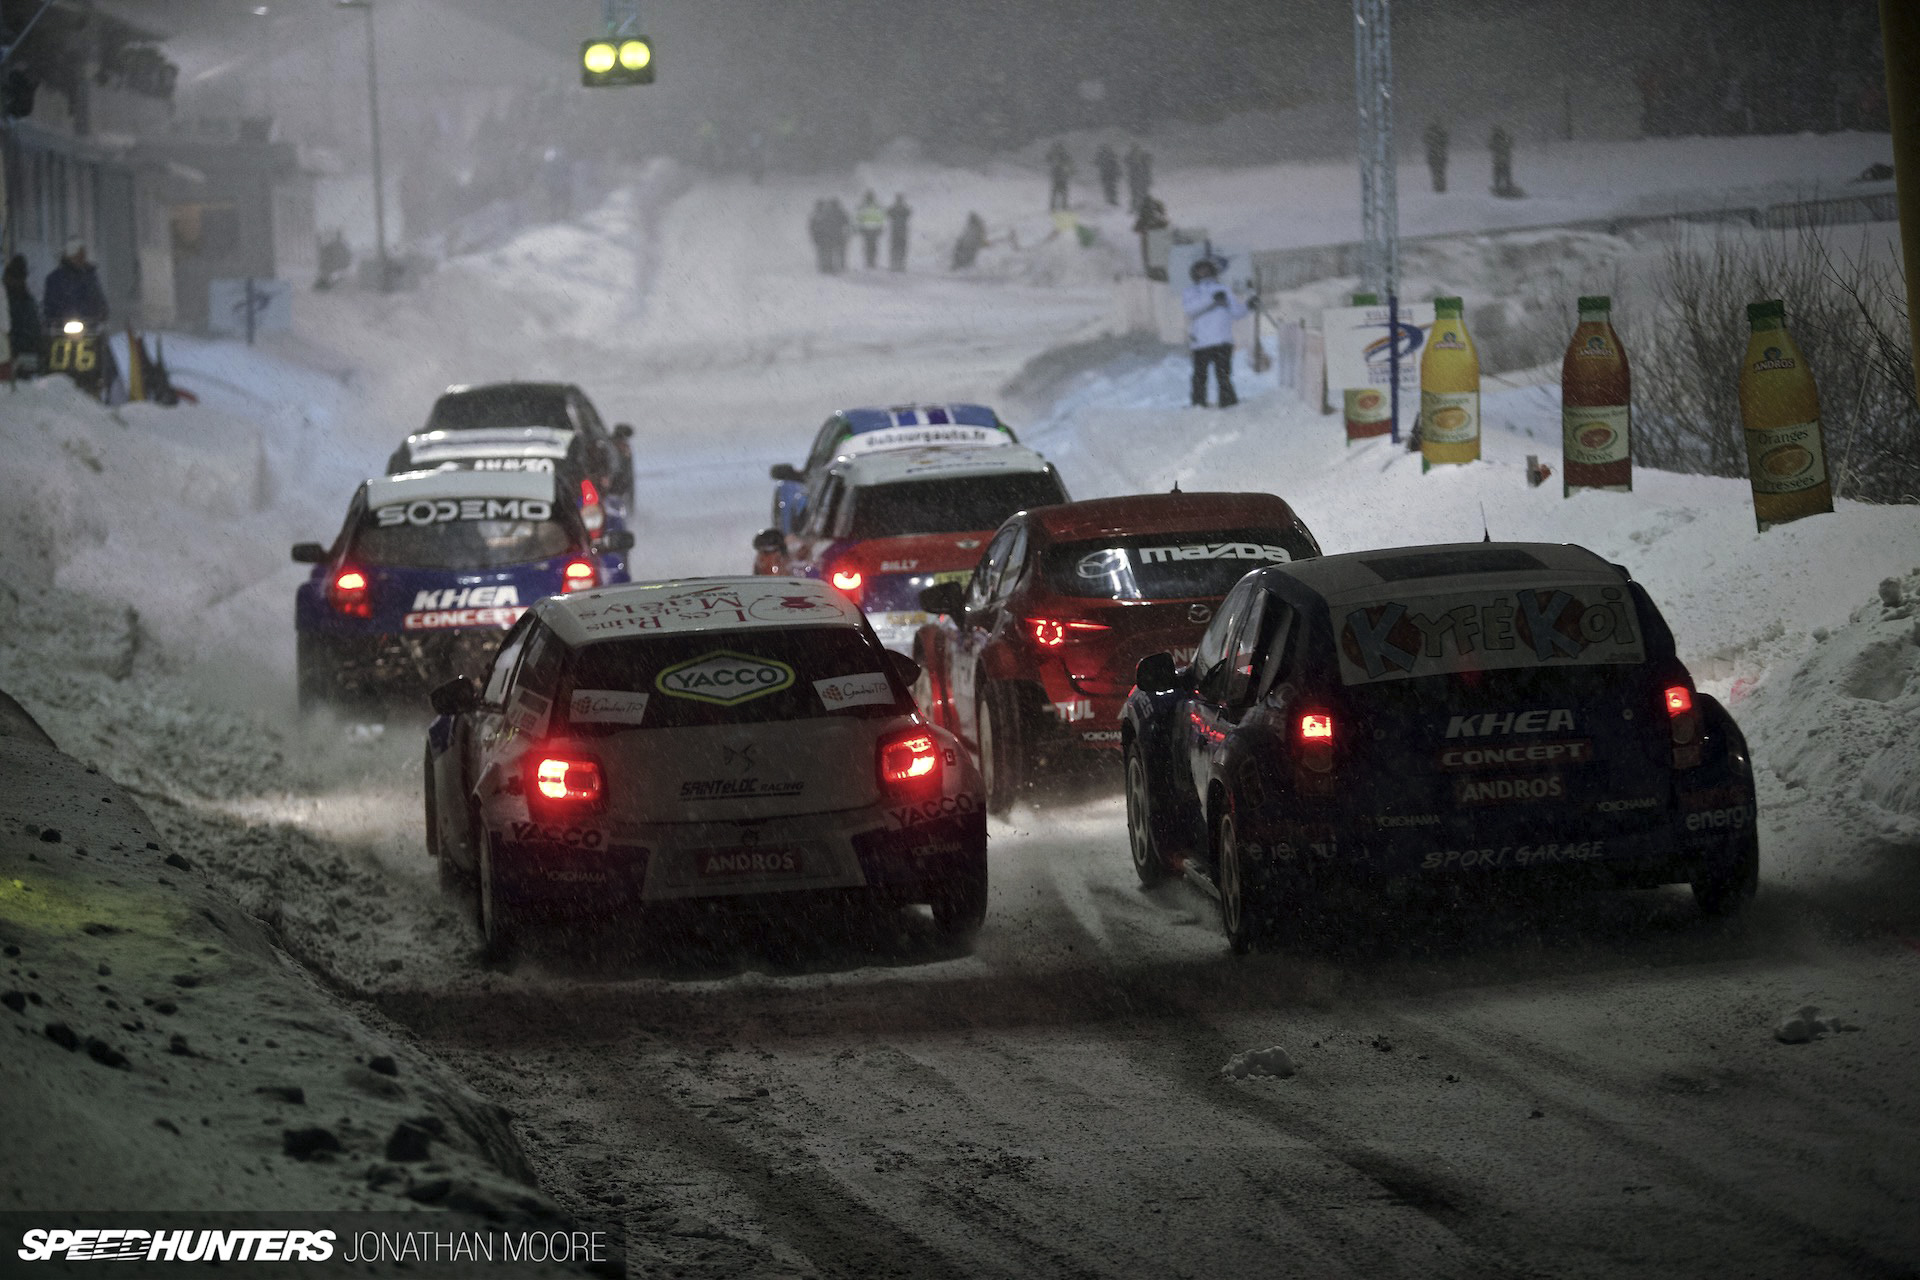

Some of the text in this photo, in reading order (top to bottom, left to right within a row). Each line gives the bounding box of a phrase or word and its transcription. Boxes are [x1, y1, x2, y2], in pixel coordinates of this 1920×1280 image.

[49, 336, 97, 372] 06
[1754, 359, 1794, 371] ANDROS
[1759, 430, 1808, 445] Oranges
[376, 500, 553, 527] SODEMO
[411, 585, 520, 612] KHEA
[675, 668, 778, 688] YACCO
[1445, 709, 1576, 738] KHEA
[1441, 743, 1585, 766] CONCEPT
[1463, 776, 1562, 802] ANDROS
[888, 793, 973, 829] YACCO
[1374, 814, 1441, 827] YOKOHAMA
[511, 822, 603, 849] YACCO
[705, 852, 796, 874] ANDROS
[1515, 841, 1605, 867] GARAGE
